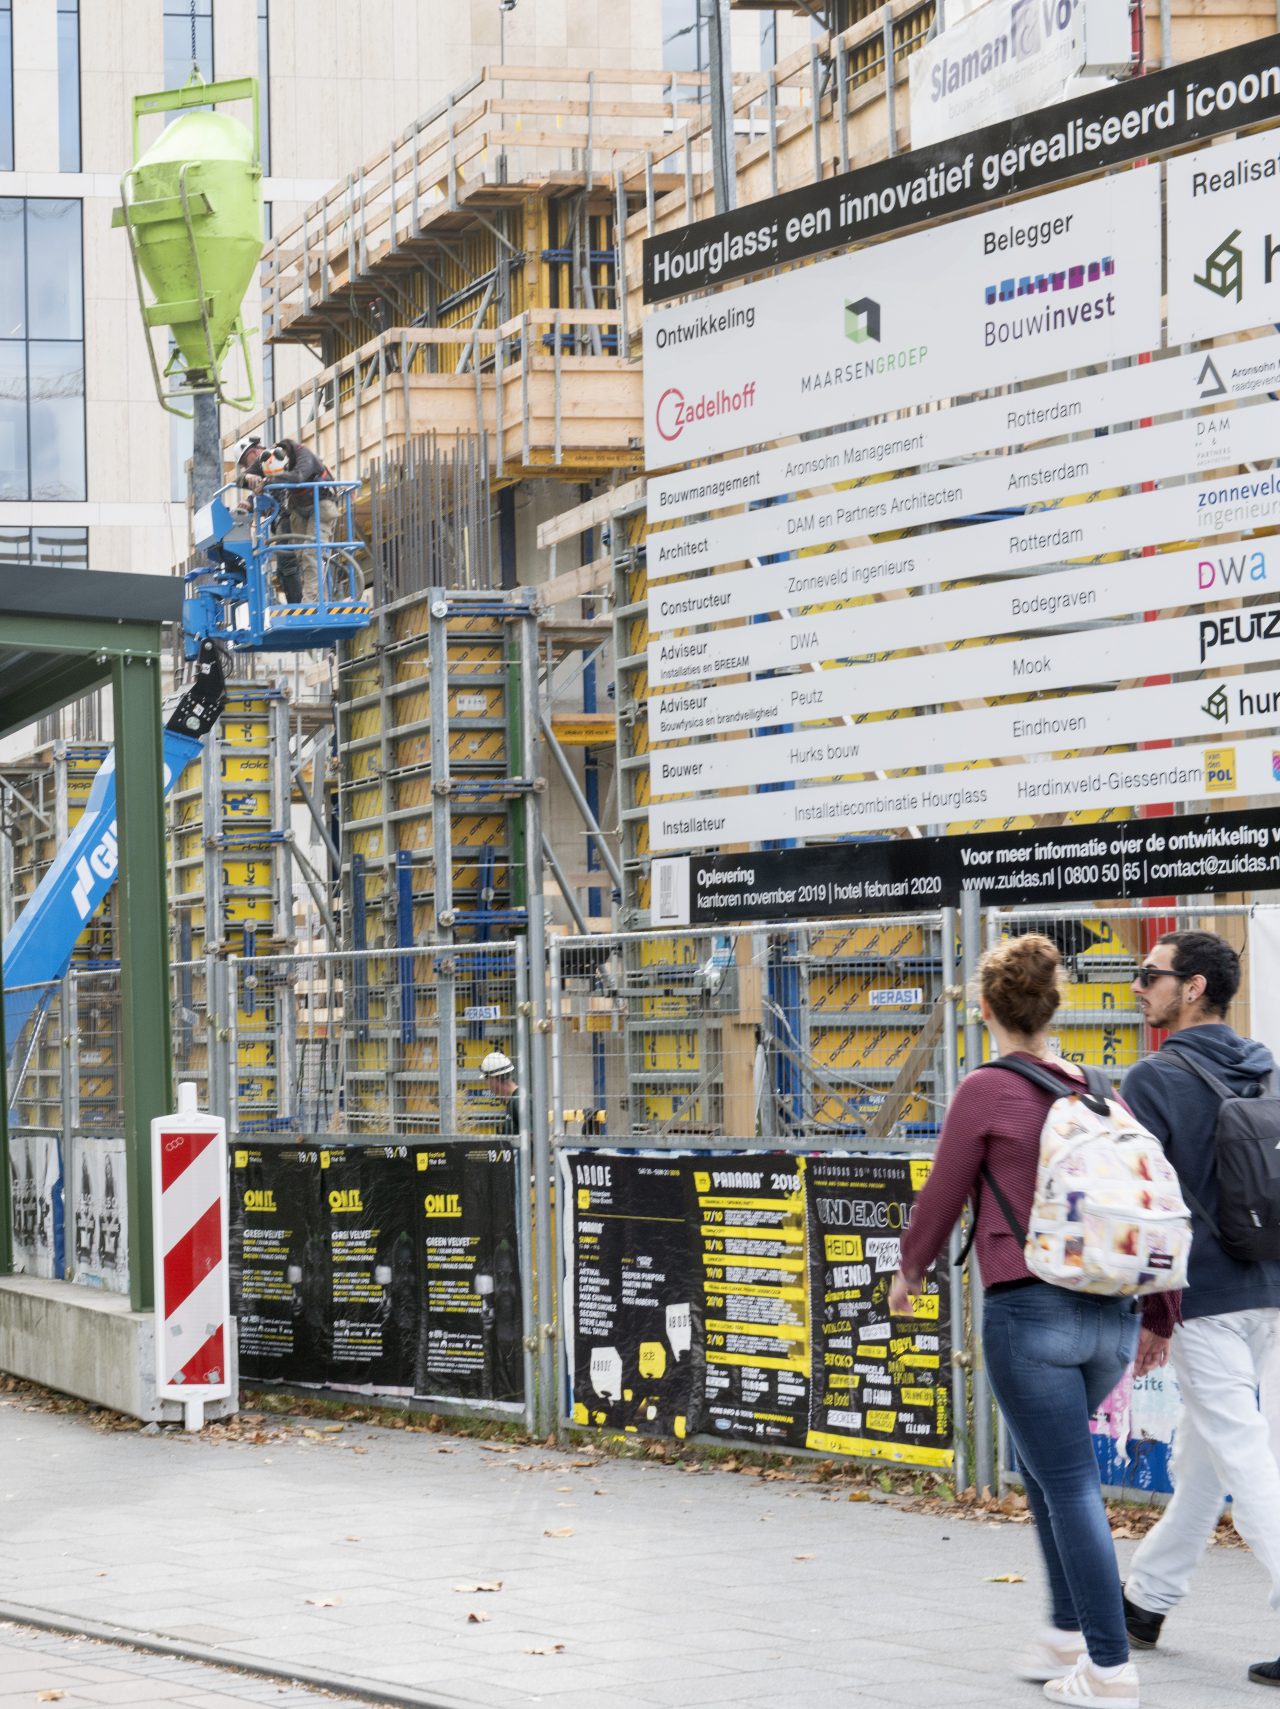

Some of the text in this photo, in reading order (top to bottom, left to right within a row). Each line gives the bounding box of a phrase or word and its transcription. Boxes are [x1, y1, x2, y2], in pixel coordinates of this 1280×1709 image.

[931, 33, 1007, 103] Slaman
[653, 66, 1280, 285] Hourglass: een innovatief gerealiseerd icoon
[1193, 156, 1280, 197] Realisa
[984, 214, 1074, 255] Belegger
[656, 306, 755, 348] Ontwikkeling
[985, 292, 1116, 347] Bouwinvest
[801, 346, 929, 393] MAARSENGROEP
[1197, 417, 1231, 436] DAM
[660, 400, 1082, 506] Bouwmanagement Aronsohn Management Rotterdam
[659, 460, 1089, 561] Architect DAM en Partners Architecten Amsterdam
[1197, 500, 1280, 530] ingenieur
[661, 526, 1083, 617] Constructeur Zonneveld ingenieurs Rotterdam
[660, 587, 1096, 662] Adviseur DWA Bodegraven
[714, 655, 750, 671] BREEAM
[659, 655, 1051, 714] Adviseur Peutz Mook
[662, 714, 1086, 779] Bouwer Hurks bouw Eindhoven
[1208, 769, 1233, 782] POL
[663, 767, 1203, 835] Installateur Installatiecombinatie Hourglass Hardinxveld-Giessendam
[960, 848, 993, 866] Voor
[996, 847, 1030, 863] meer
[1034, 839, 1107, 860] informatie
[1110, 839, 1145, 855] over
[1146, 833, 1166, 851] de
[1168, 826, 1269, 850] ontwikkeling
[697, 867, 755, 887] Oplevering
[962, 868, 1055, 891] www.zuidas.nl
[1064, 864, 1098, 885] 0800
[1102, 863, 1120, 883] 50
[1123, 862, 1140, 881] 65
[1151, 852, 1280, 880] contact@zuidas.n
[697, 891, 741, 909] kantoren
[743, 887, 796, 906] november
[798, 884, 827, 903] 2019
[834, 882, 863, 900] hotel
[864, 878, 909, 898] februari
[911, 876, 942, 895] 2020
[770, 1173, 803, 1191] 2018
[425, 1194, 446, 1212] ON
